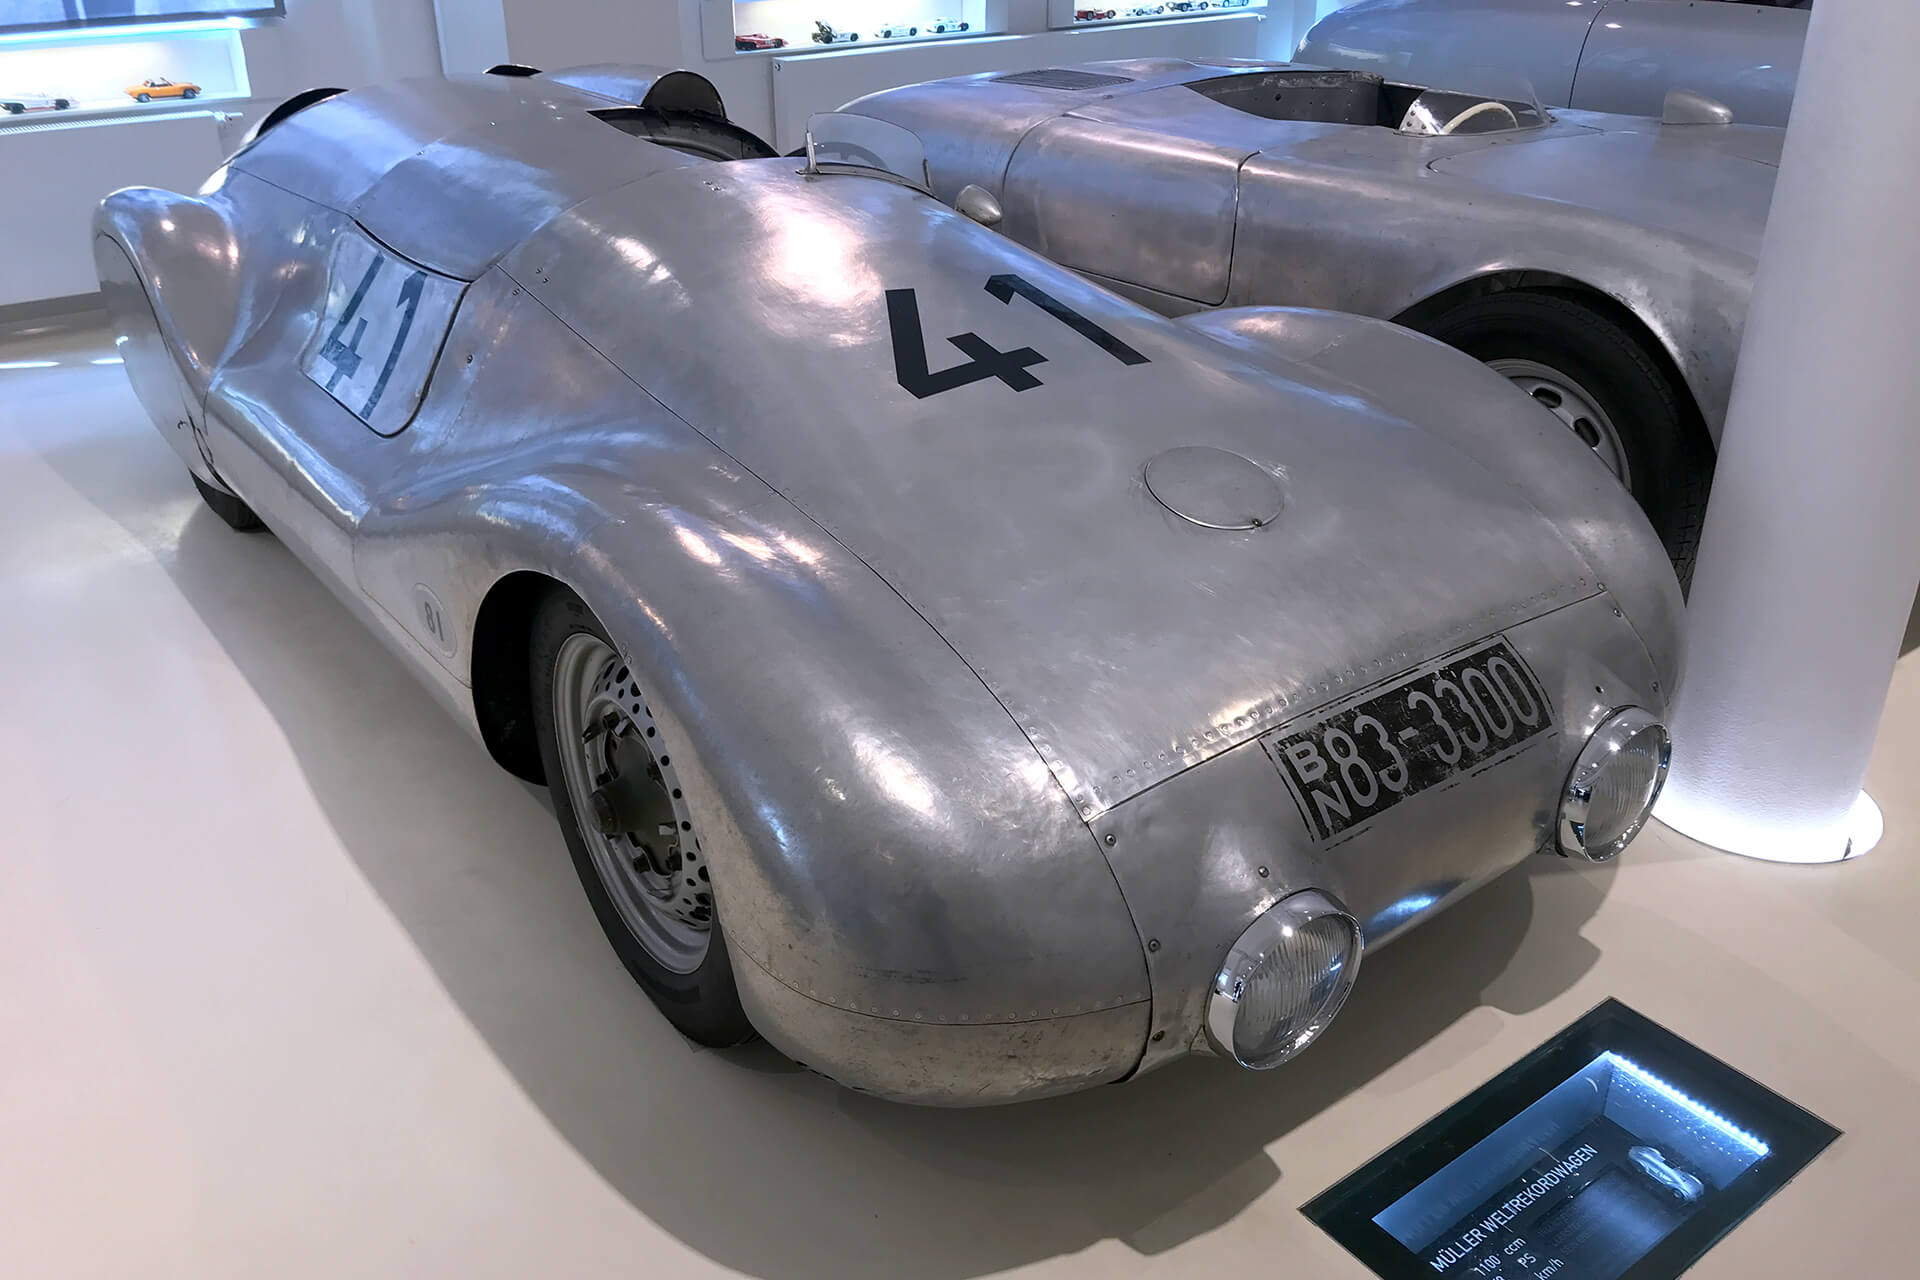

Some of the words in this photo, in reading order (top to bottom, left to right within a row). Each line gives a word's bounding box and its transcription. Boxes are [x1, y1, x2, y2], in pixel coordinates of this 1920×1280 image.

[319, 250, 428, 421] 41
[885, 274, 1152, 399] 41
[1323, 656, 1540, 808] 83-3300
[1429, 1228, 1488, 1273] MÜLLER
[1479, 1143, 1599, 1234] WELTREKORDWAGEN
[1473, 1255, 1501, 1276] 1100
[1504, 1237, 1527, 1255] ccm
[1517, 1252, 1537, 1269] PS
[1534, 1258, 1565, 1280] km/h
